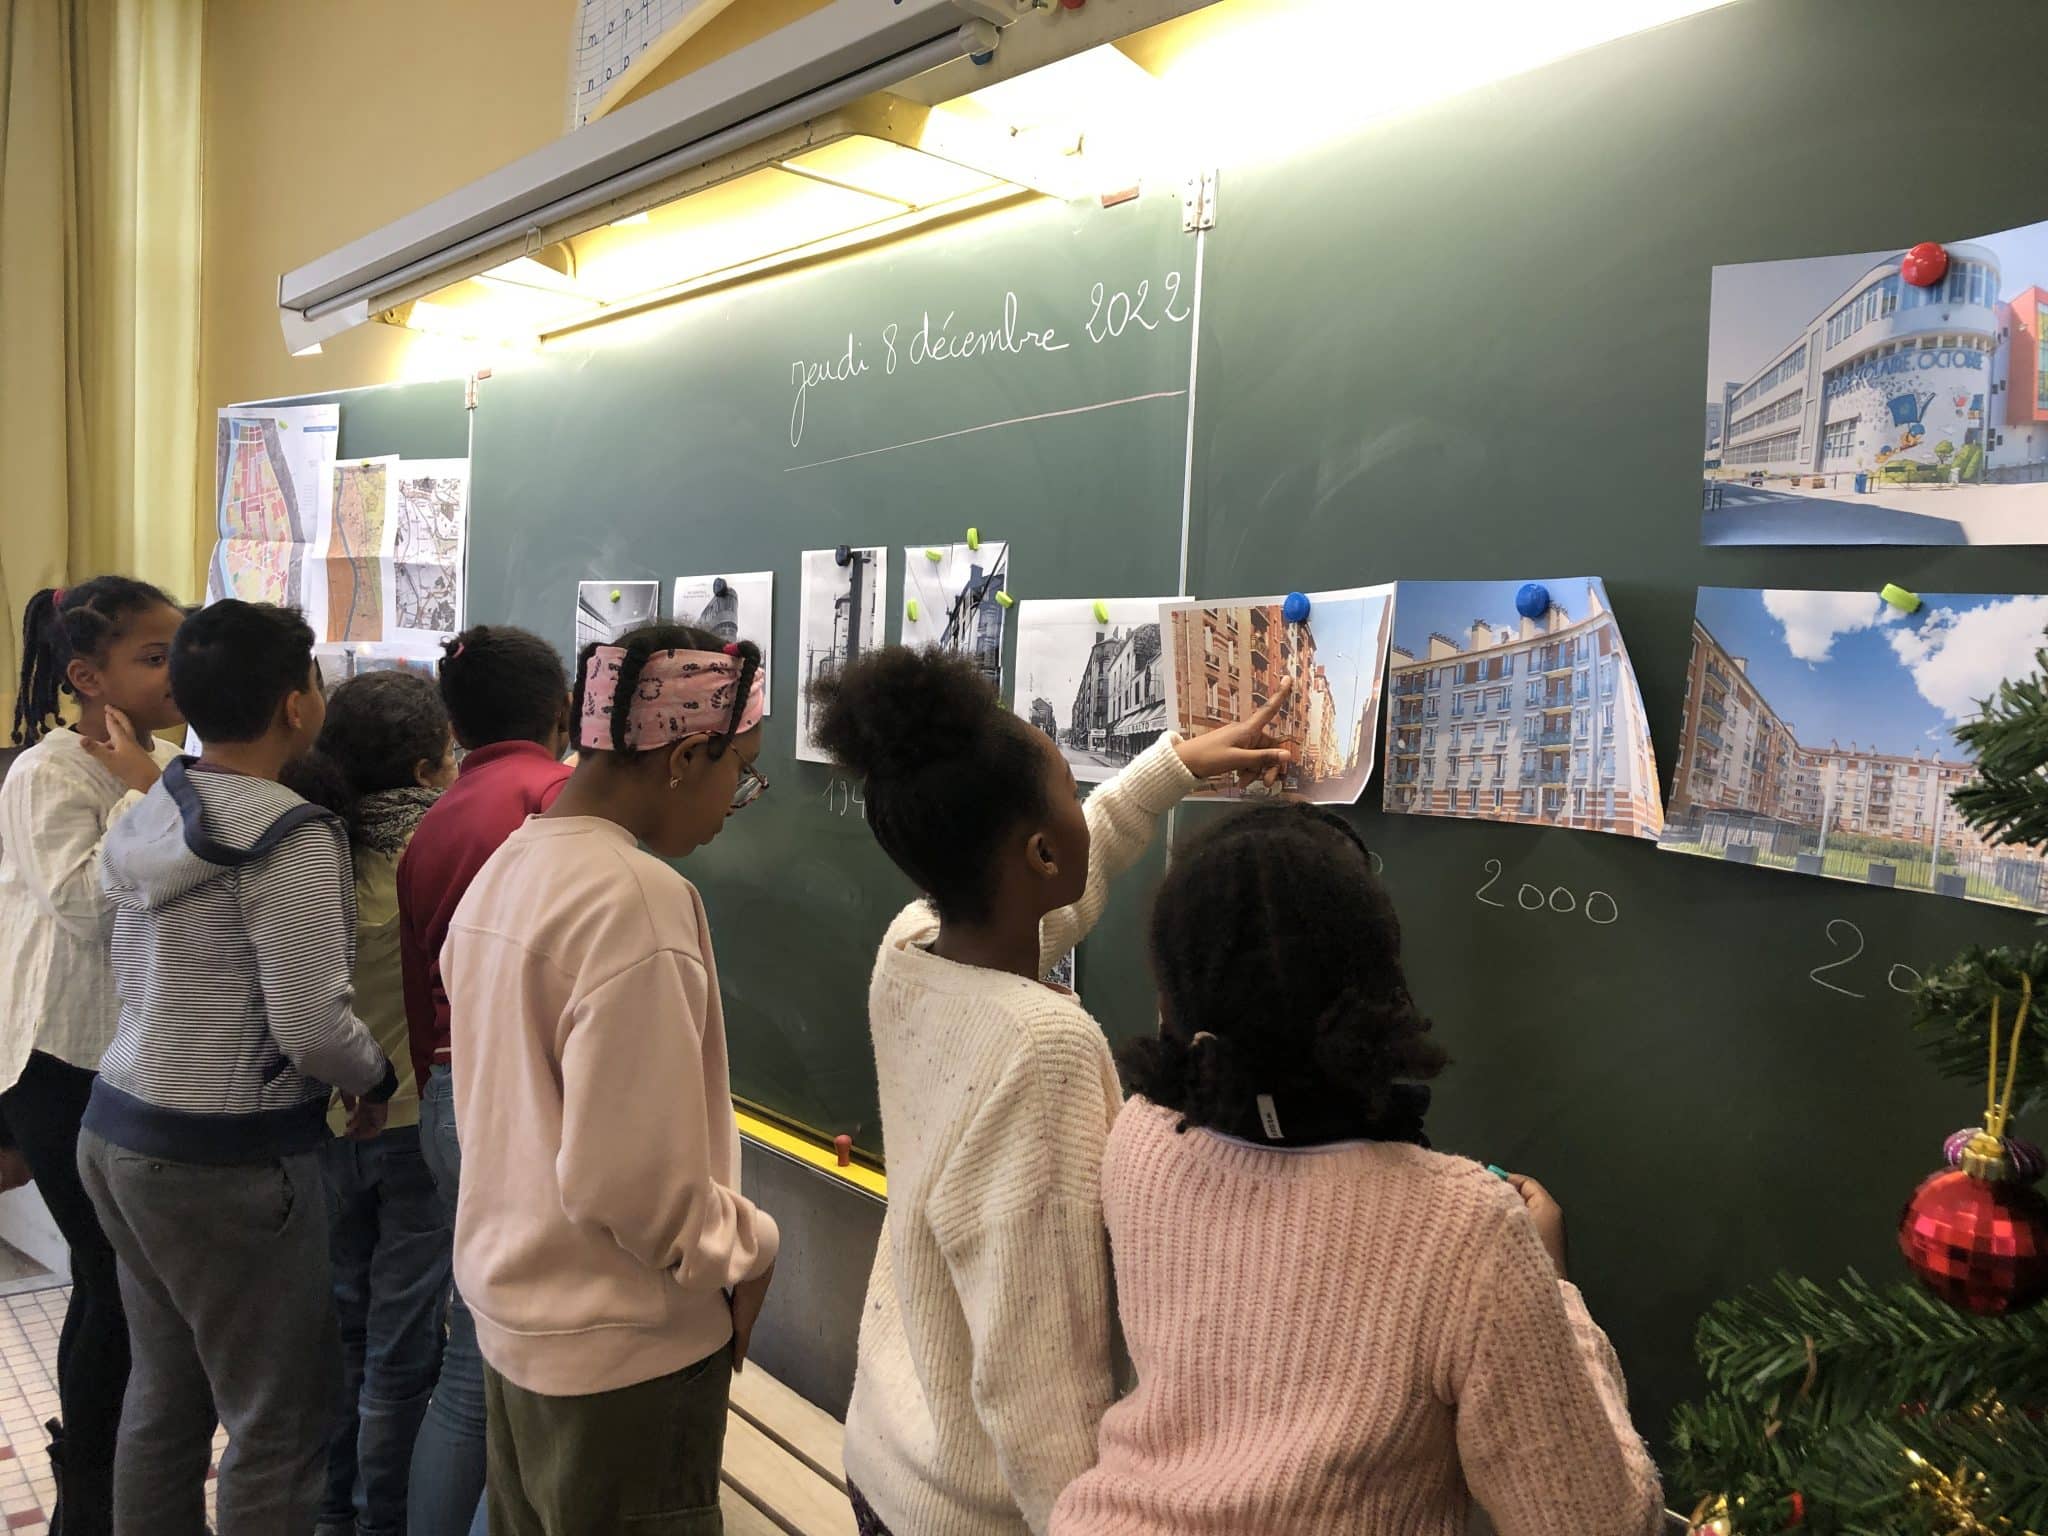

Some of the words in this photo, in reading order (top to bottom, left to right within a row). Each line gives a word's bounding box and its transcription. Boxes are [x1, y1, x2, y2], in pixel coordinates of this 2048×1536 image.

[882, 323, 898, 374] 8
[910, 291, 1070, 365] décembre
[1085, 271, 1190, 343] 2022
[822, 777, 867, 819] 194
[1476, 859, 1618, 924] 2000
[1809, 918, 1923, 998] 20
